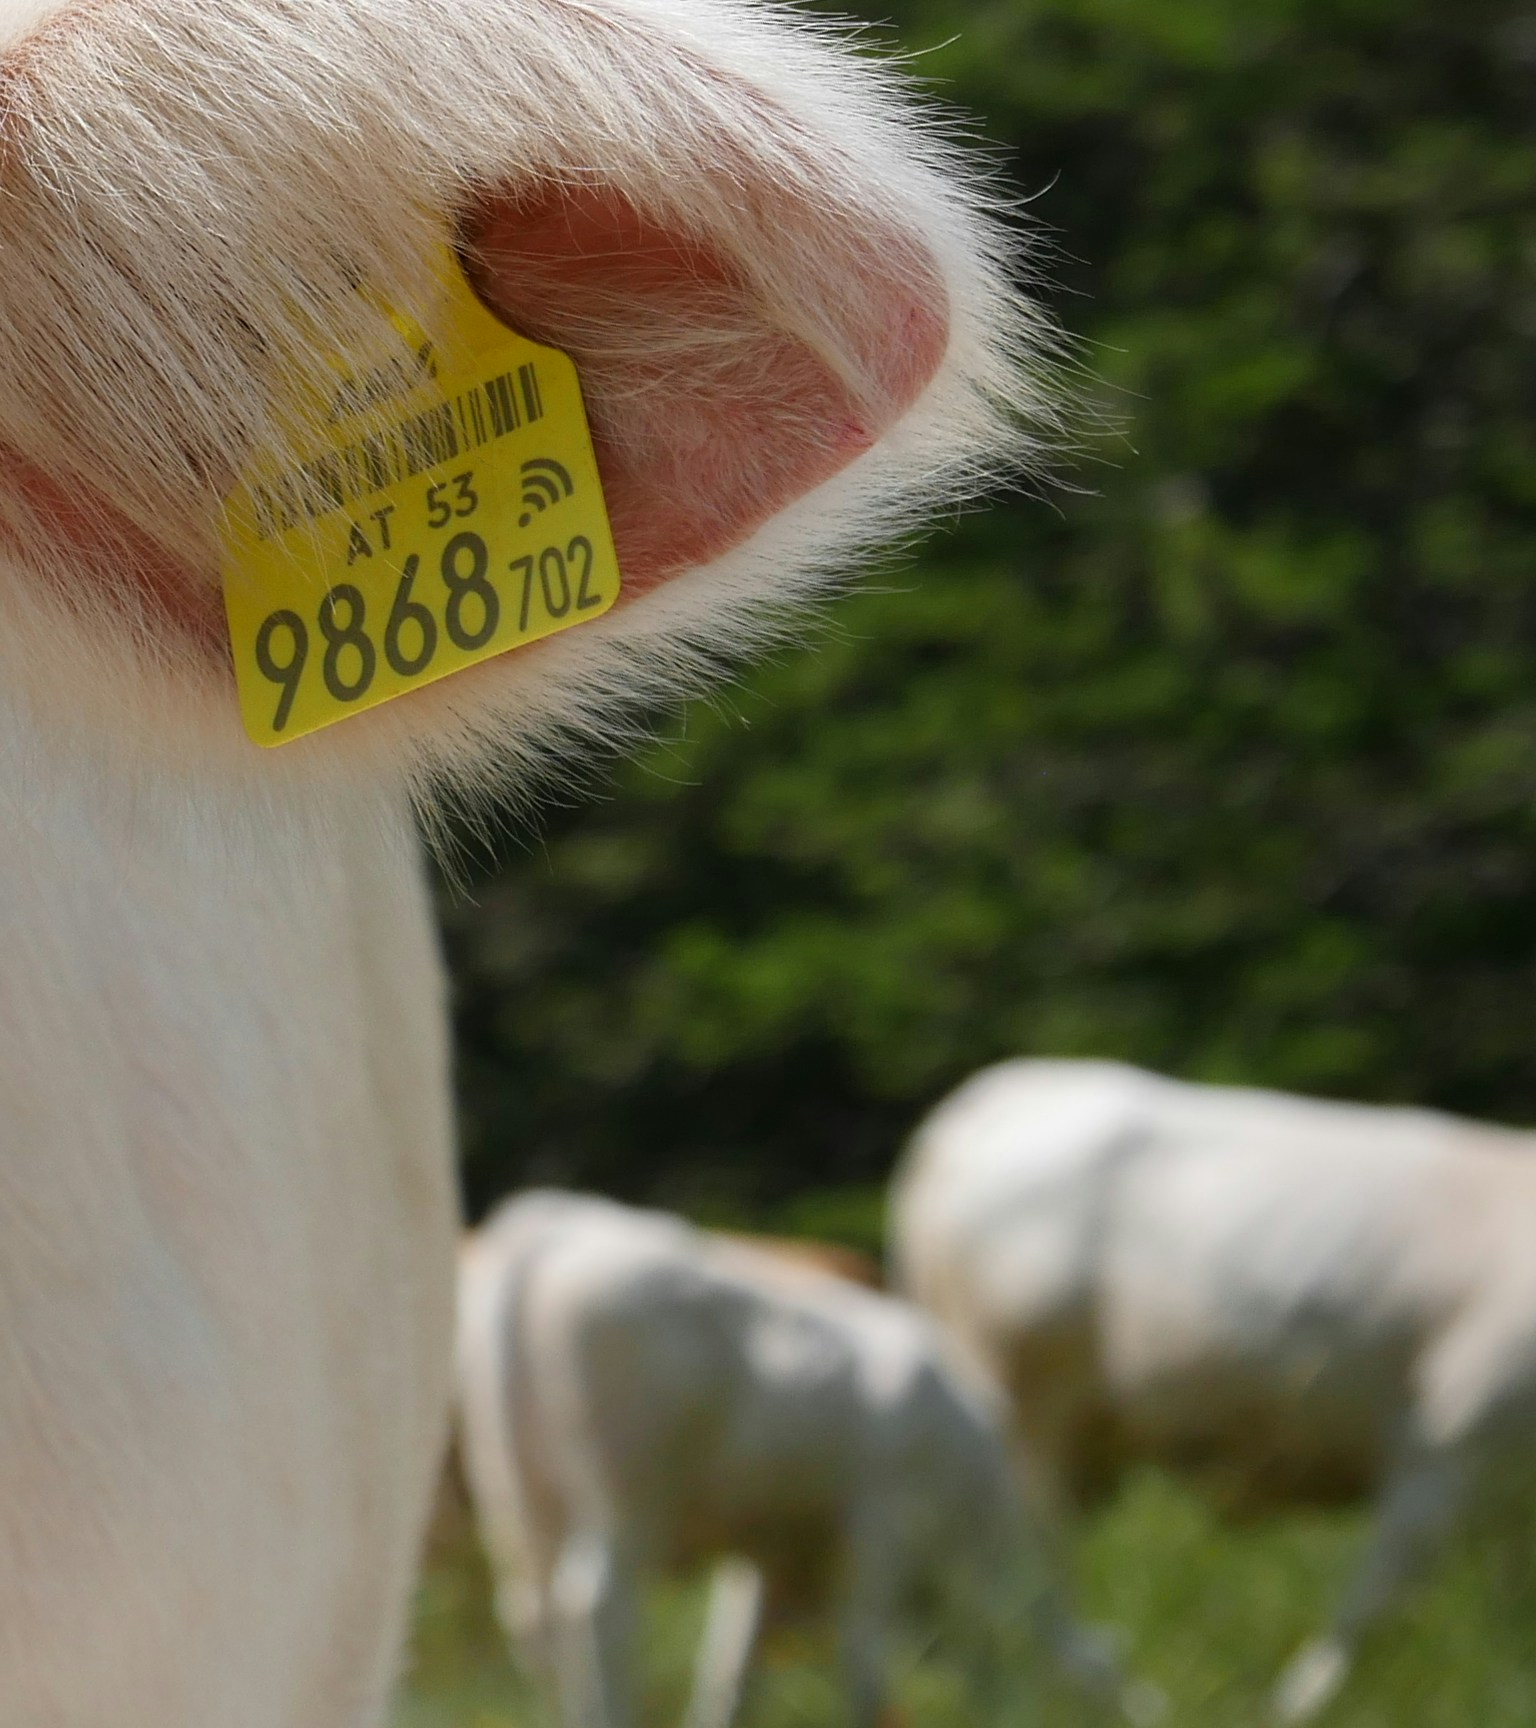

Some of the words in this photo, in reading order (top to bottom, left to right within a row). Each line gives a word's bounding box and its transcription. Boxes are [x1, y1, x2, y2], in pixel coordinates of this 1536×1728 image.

[347, 505, 394, 564] AT
[427, 471, 479, 529] 53
[255, 531, 500, 732] 9868
[509, 535, 602, 632] 702
